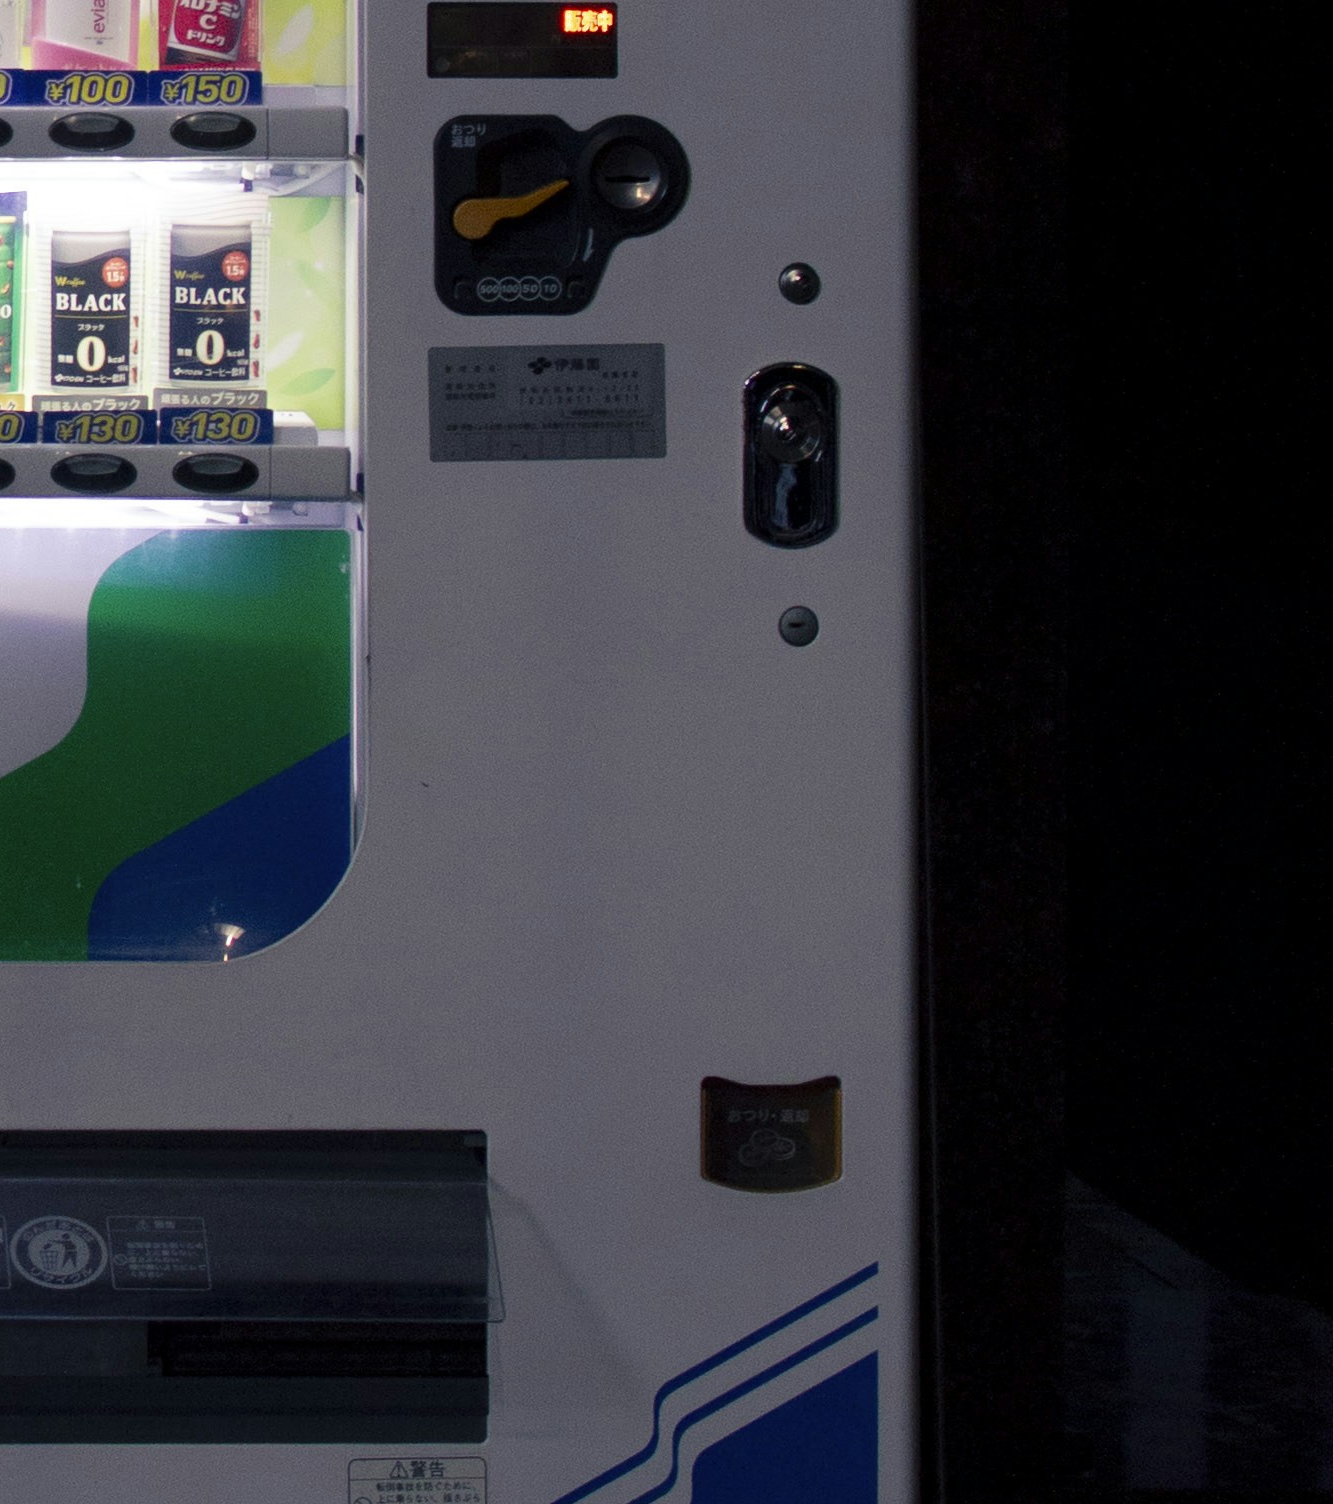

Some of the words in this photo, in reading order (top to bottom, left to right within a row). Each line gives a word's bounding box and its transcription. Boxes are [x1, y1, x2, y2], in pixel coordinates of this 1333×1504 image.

[199, 14, 217, 30] C
[563, 8, 614, 33] 販売中
[186, 28, 226, 46] ドリンク
[48, 74, 130, 104] ¥100
[164, 75, 244, 104] ¥150
[450, 123, 487, 136] おつり
[174, 286, 246, 306] BLACK
[522, 282, 538, 294] 50
[542, 282, 558, 294] 10
[55, 293, 126, 312] BLACK
[77, 323, 105, 332] ブラック
[196, 317, 224, 325] ブラック
[76, 336, 106, 372] 0
[196, 329, 225, 366] 0
[58, 414, 139, 442] ¥130
[174, 413, 256, 441] ¥130
[410, 1460, 444, 1478] 警告
